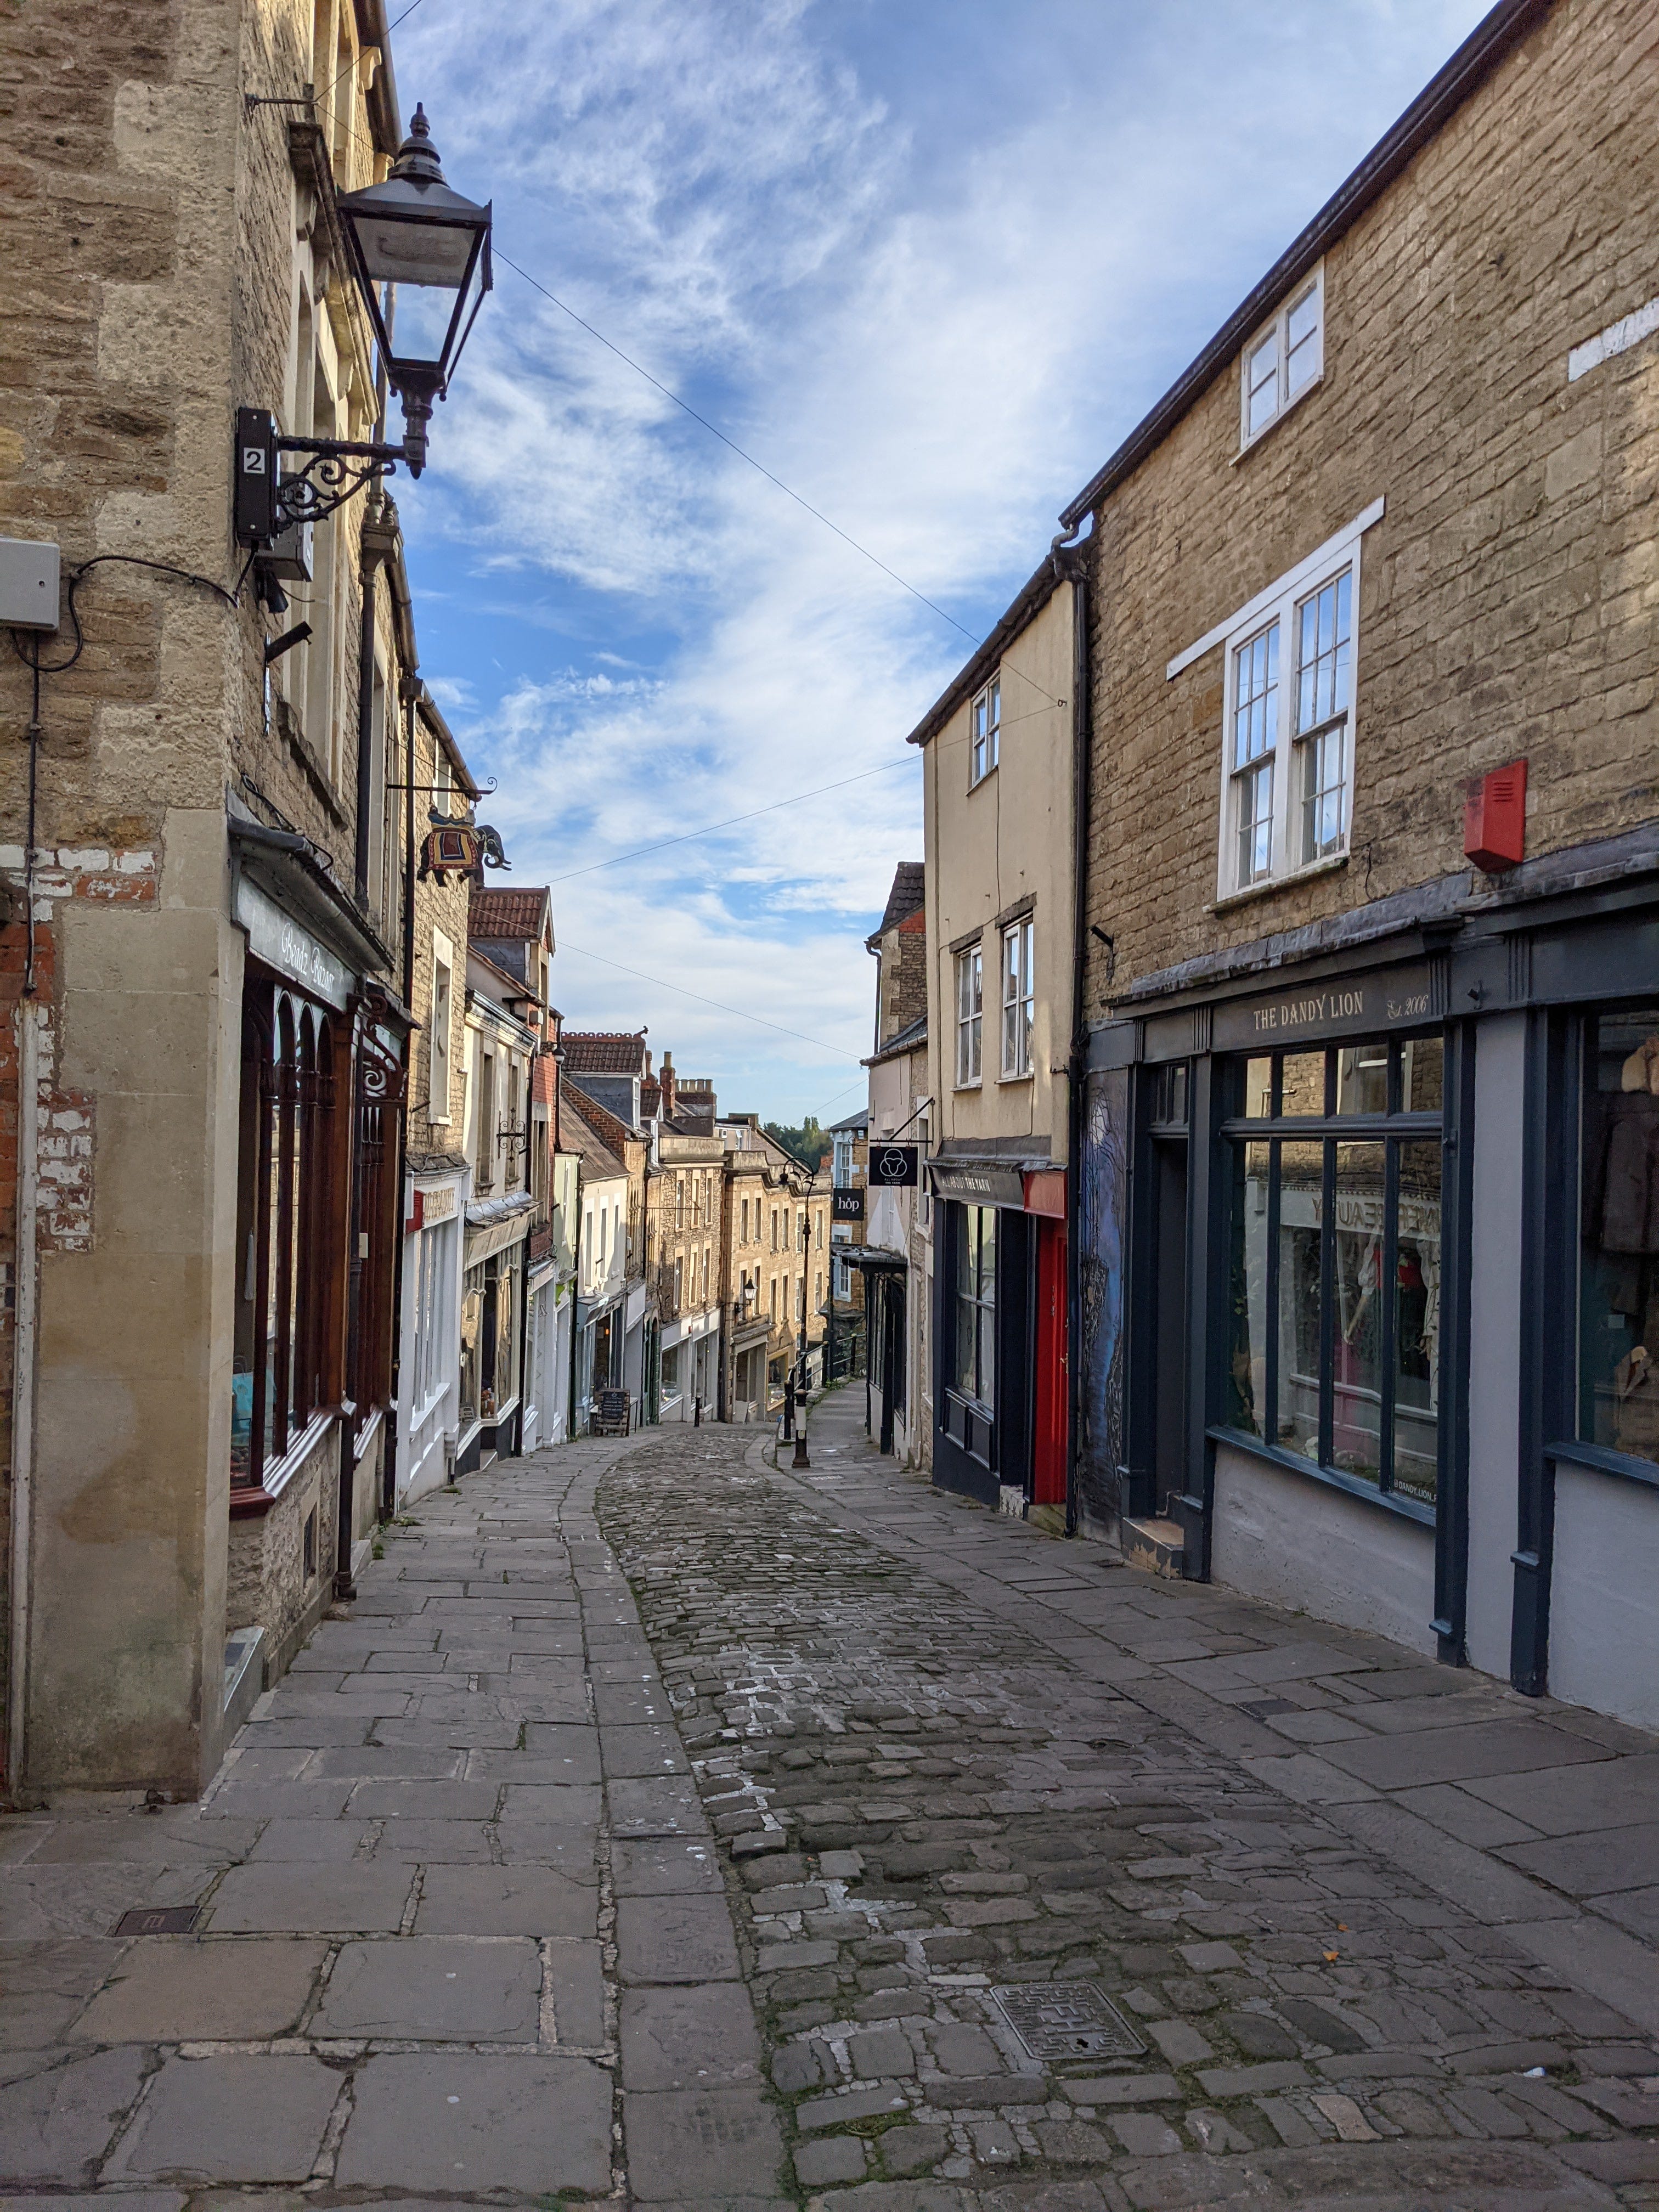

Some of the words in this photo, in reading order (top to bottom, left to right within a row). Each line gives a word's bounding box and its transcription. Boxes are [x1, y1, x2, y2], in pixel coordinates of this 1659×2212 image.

[247, 451, 262, 471] 2
[281, 922, 308, 977] Beadz
[311, 946, 335, 992] Bazaar
[1254, 1007, 1277, 1031] THE
[1281, 994, 1326, 1026] DANDY
[1330, 991, 1363, 1019] LION
[1404, 995, 1429, 1016] 2006
[942, 1176, 950, 1187] ALL
[950, 1176, 966, 1189] ABOUT
[965, 1177, 976, 1190] THE
[974, 1177, 991, 1192] YARN
[838, 1197, 859, 1212] hop
